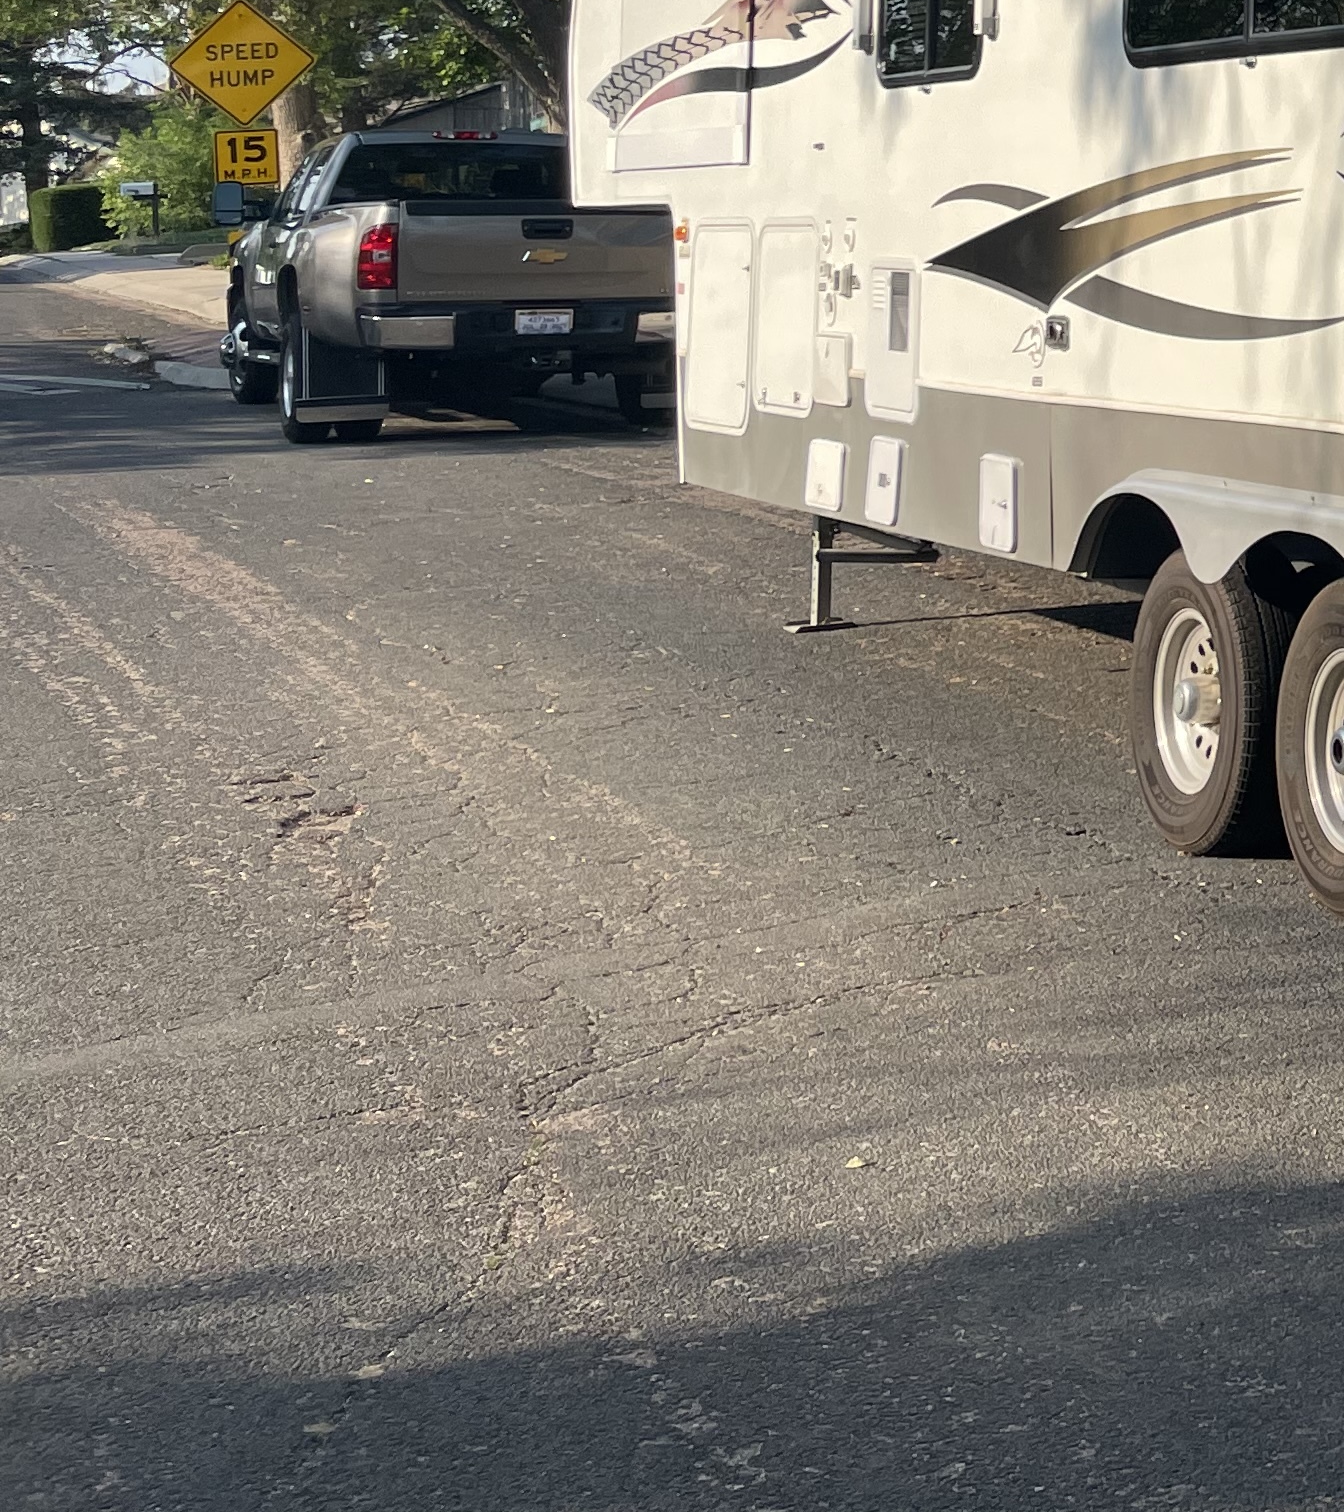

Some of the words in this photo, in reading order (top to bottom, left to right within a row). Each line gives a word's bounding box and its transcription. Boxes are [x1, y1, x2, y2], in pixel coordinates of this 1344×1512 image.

[205, 42, 279, 61] SPEED
[209, 69, 275, 88] HUMP
[227, 136, 267, 164] 15
